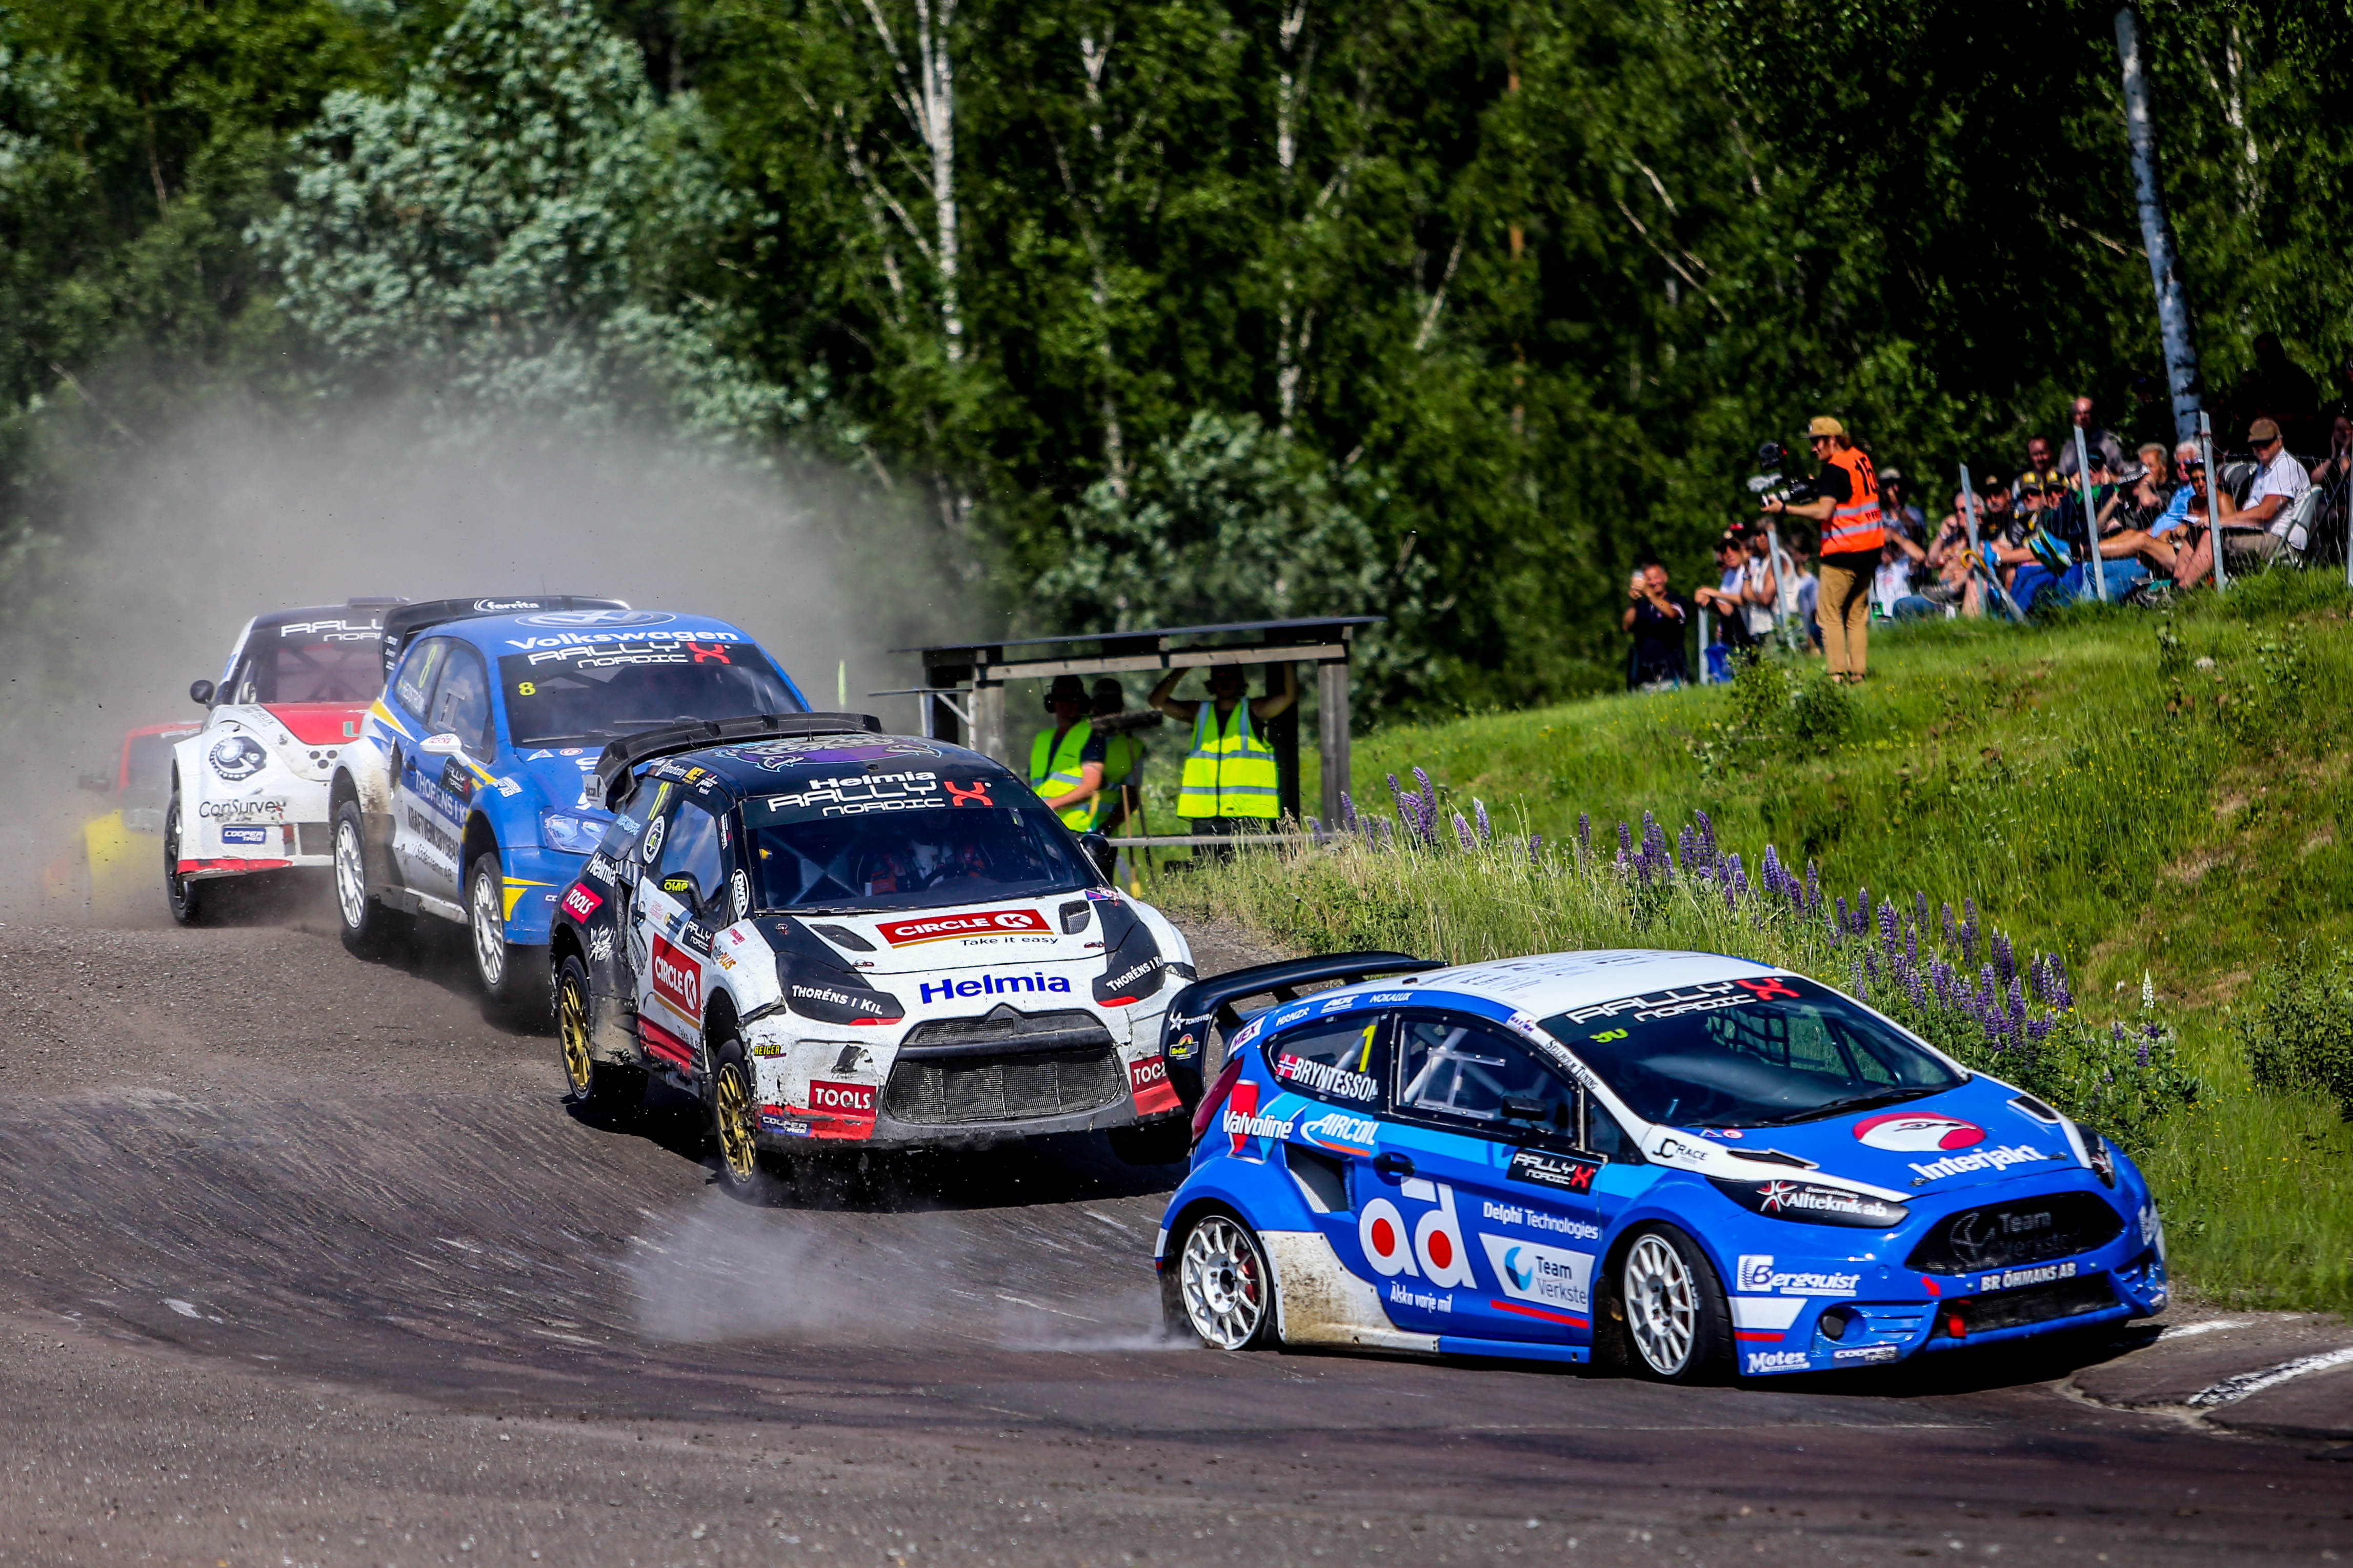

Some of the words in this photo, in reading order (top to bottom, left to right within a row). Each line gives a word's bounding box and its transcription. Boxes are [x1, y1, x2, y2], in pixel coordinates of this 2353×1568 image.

[486, 600, 540, 610] ferrita
[281, 619, 383, 637] RALL
[506, 630, 739, 649] Volkswagen
[528, 641, 681, 666] RALLY
[687, 642, 731, 664] X
[577, 655, 688, 668] NORDIC
[418, 645, 437, 688] 8
[518, 682, 536, 696] 8
[809, 771, 937, 790] Helmia
[767, 782, 938, 812] RALLY
[944, 781, 993, 806] X
[822, 797, 946, 817] NORDIC
[199, 799, 286, 819] ConSurvey
[586, 851, 616, 887] Helmia
[663, 881, 689, 892] OMP
[735, 873, 747, 907] PWR
[566, 888, 594, 914] TOOLS
[687, 921, 712, 941] RALLY
[895, 918, 991, 936] CIRCLE
[1000, 915, 1031, 928] K
[690, 936, 709, 951] NORDIC
[960, 938, 998, 946] Take
[719, 951, 736, 970] PLUS
[654, 955, 683, 995] CIRCLE
[1105, 962, 1151, 992] THORÉNS
[792, 984, 848, 1005] THORÉNS
[860, 1000, 884, 1015] KIL
[919, 972, 1071, 1004] Helmia
[1565, 981, 1735, 1025] RALLY
[1736, 977, 1801, 1001] X
[1633, 993, 1758, 1023] NORDIC
[677, 1025, 690, 1043] Take
[754, 1045, 781, 1056] REIGER
[1359, 1025, 1377, 1072] 1
[815, 1088, 871, 1110] TOOLS
[762, 1116, 808, 1129] COOPER
[1222, 1110, 1294, 1139] Valvoline
[1313, 1112, 1380, 1146] AIRCOIL
[1676, 1144, 1708, 1160] RACE
[1908, 1144, 2049, 1180] Interjakt
[1513, 1152, 1577, 1174] RALLY
[1571, 1164, 1593, 1188] X
[1525, 1168, 1571, 1185] NORDIC
[1786, 1192, 1864, 1214] Allteknik
[1863, 1201, 1887, 1217] ab
[1483, 1201, 1523, 1225] Delphi
[1524, 1209, 1599, 1239] Technologies
[1998, 1210, 2052, 1234] Team
[1535, 1255, 1573, 1280] Team
[1752, 1265, 1861, 1289] Bergquist
[1980, 1274, 2001, 1292] BR
[2002, 1265, 2058, 1288] ÖHMANS
[2057, 1261, 2077, 1279] AB
[1390, 1280, 1414, 1306] Älska
[1437, 1294, 1453, 1313] mil
[1834, 1346, 1897, 1358] COOPER
